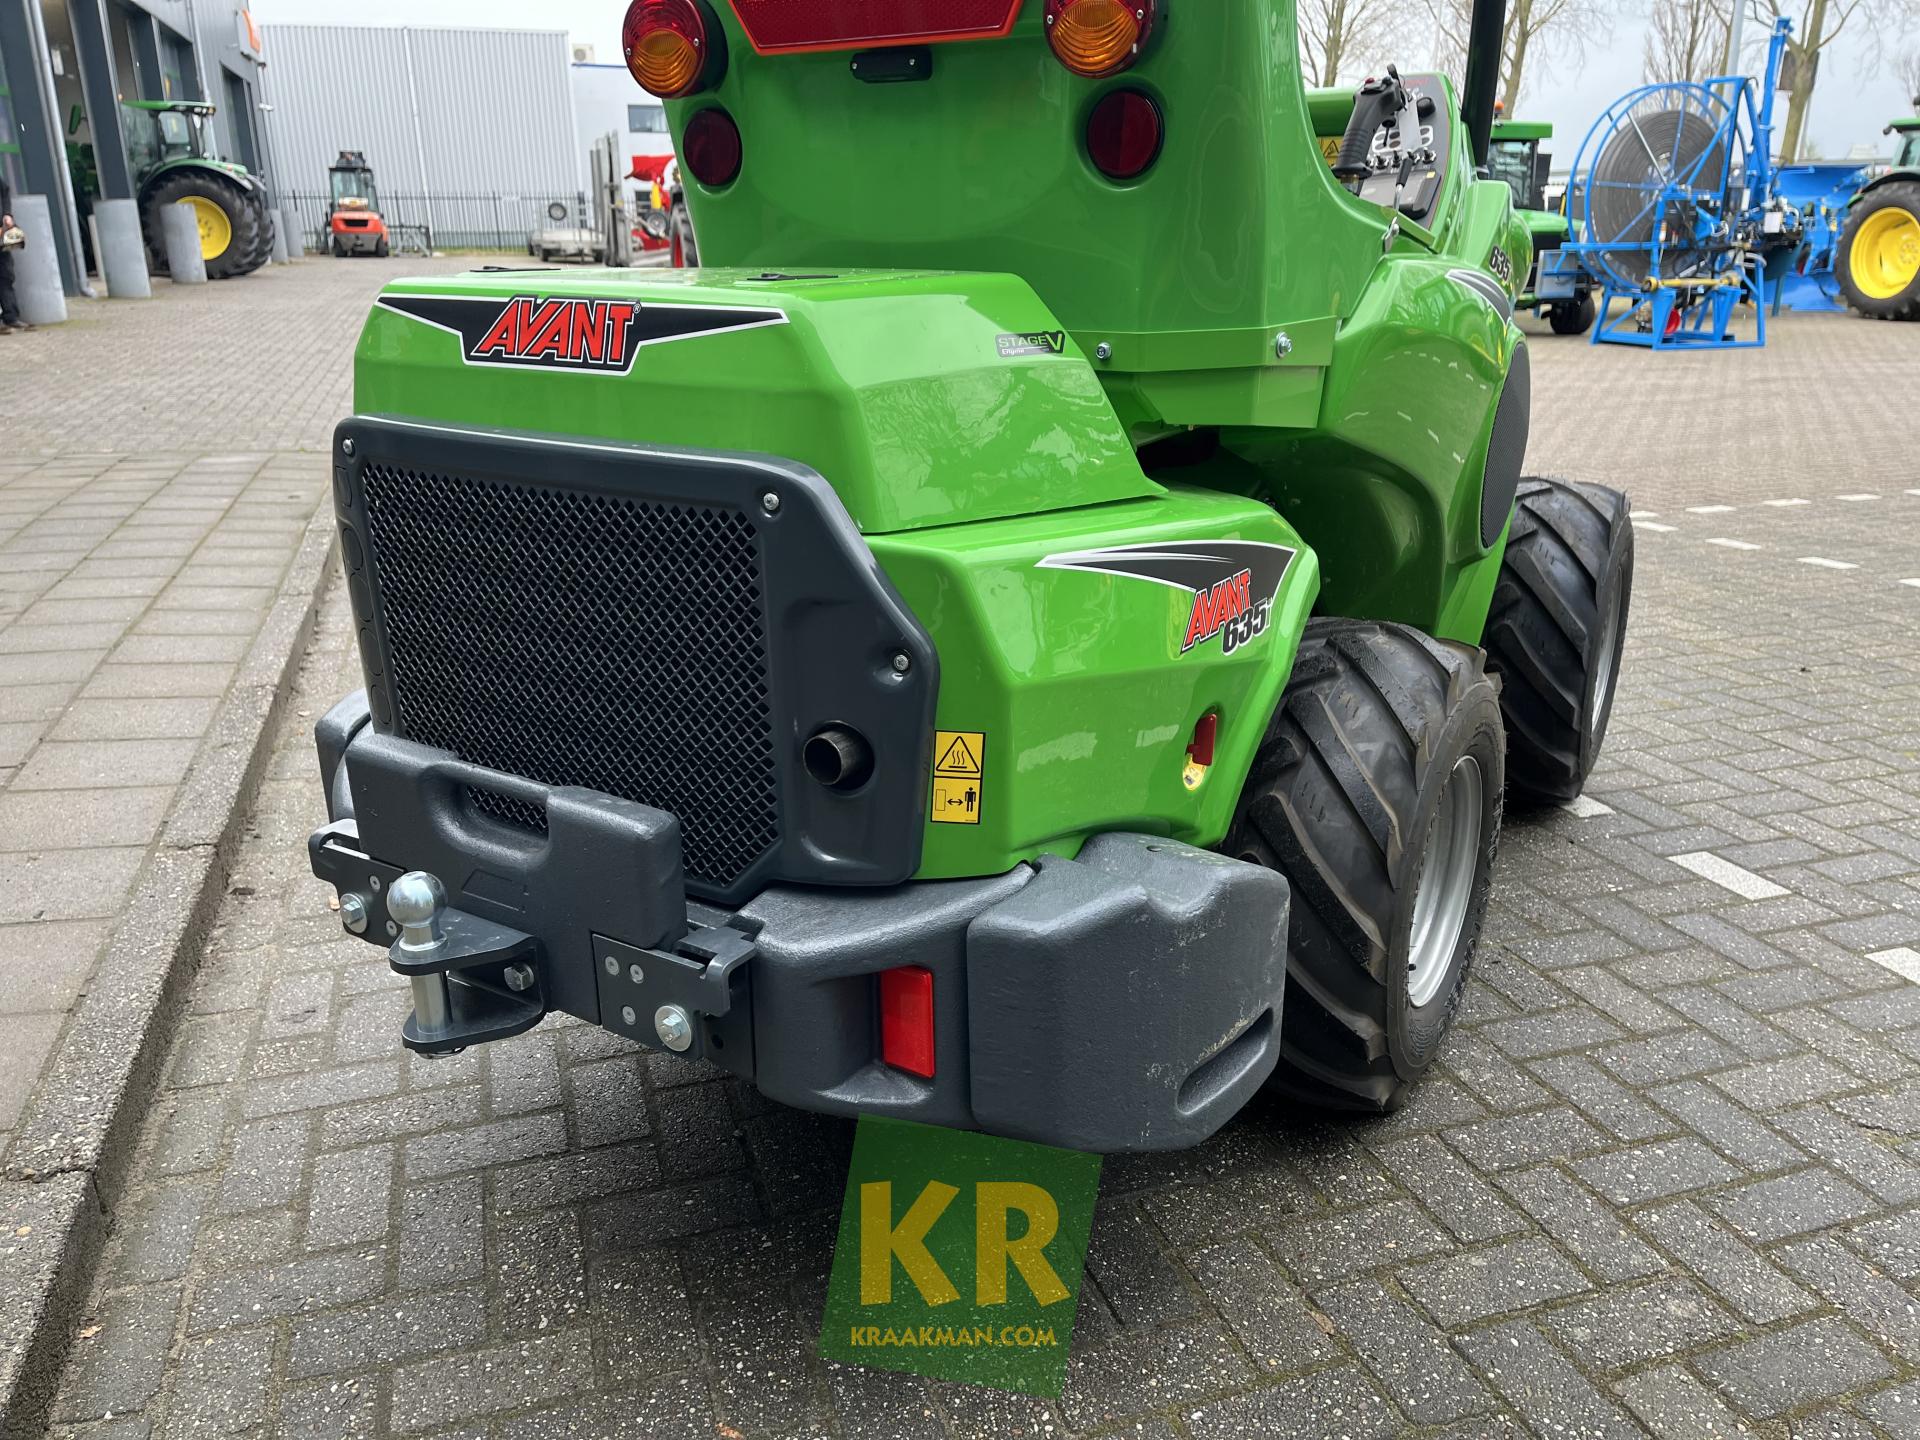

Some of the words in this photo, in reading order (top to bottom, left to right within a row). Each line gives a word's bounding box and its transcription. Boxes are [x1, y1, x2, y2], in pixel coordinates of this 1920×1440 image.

[471, 298, 634, 365] AVANT
[998, 336, 1047, 348] STAGE
[1181, 567, 1251, 652] AVANT
